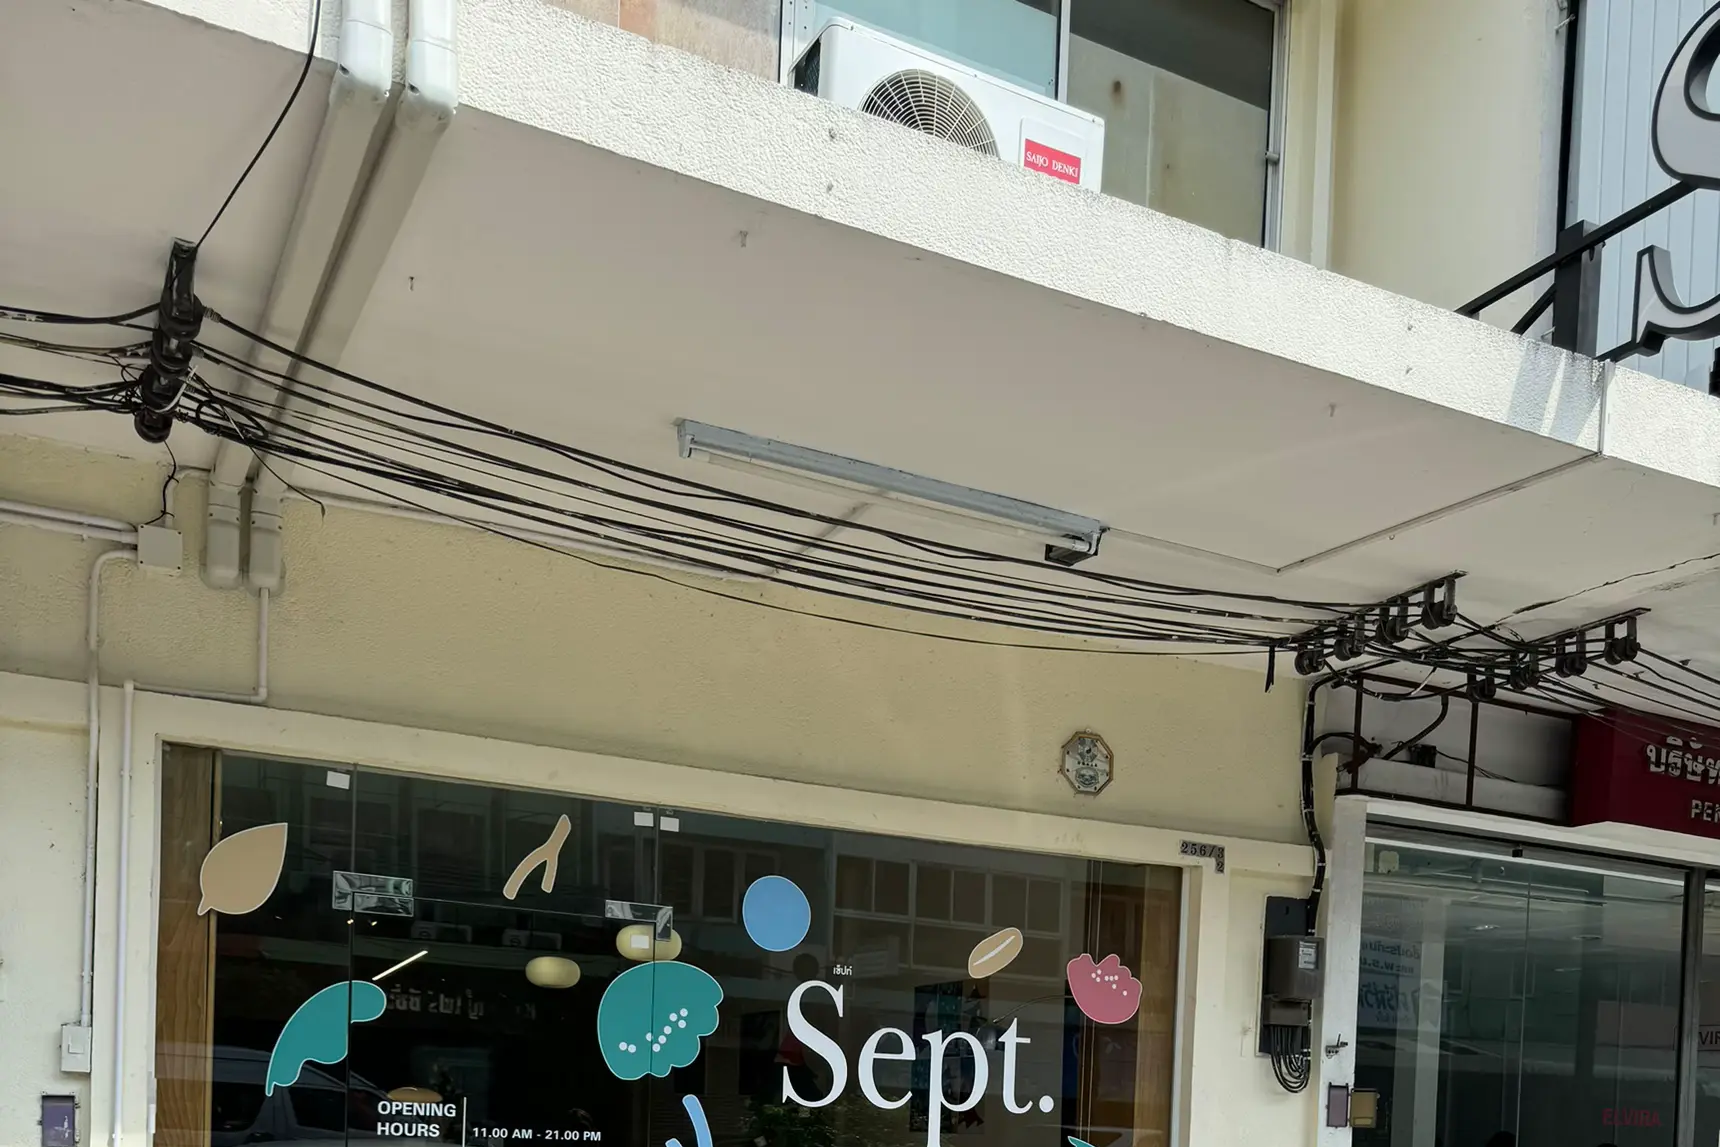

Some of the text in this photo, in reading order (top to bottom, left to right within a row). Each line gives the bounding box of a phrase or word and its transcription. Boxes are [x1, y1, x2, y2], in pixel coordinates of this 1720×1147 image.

[1026, 151, 1079, 177] SAIJO DENKI
[377, 1100, 457, 1117] OPENING
[1602, 1107, 1661, 1127] ELVIRA
[377, 1122, 441, 1138] HOURS
[472, 1127, 508, 1139] 11.00
[512, 1128, 533, 1140] AM
[545, 1129, 580, 1141] 21.00
[583, 1130, 602, 1142] PM
